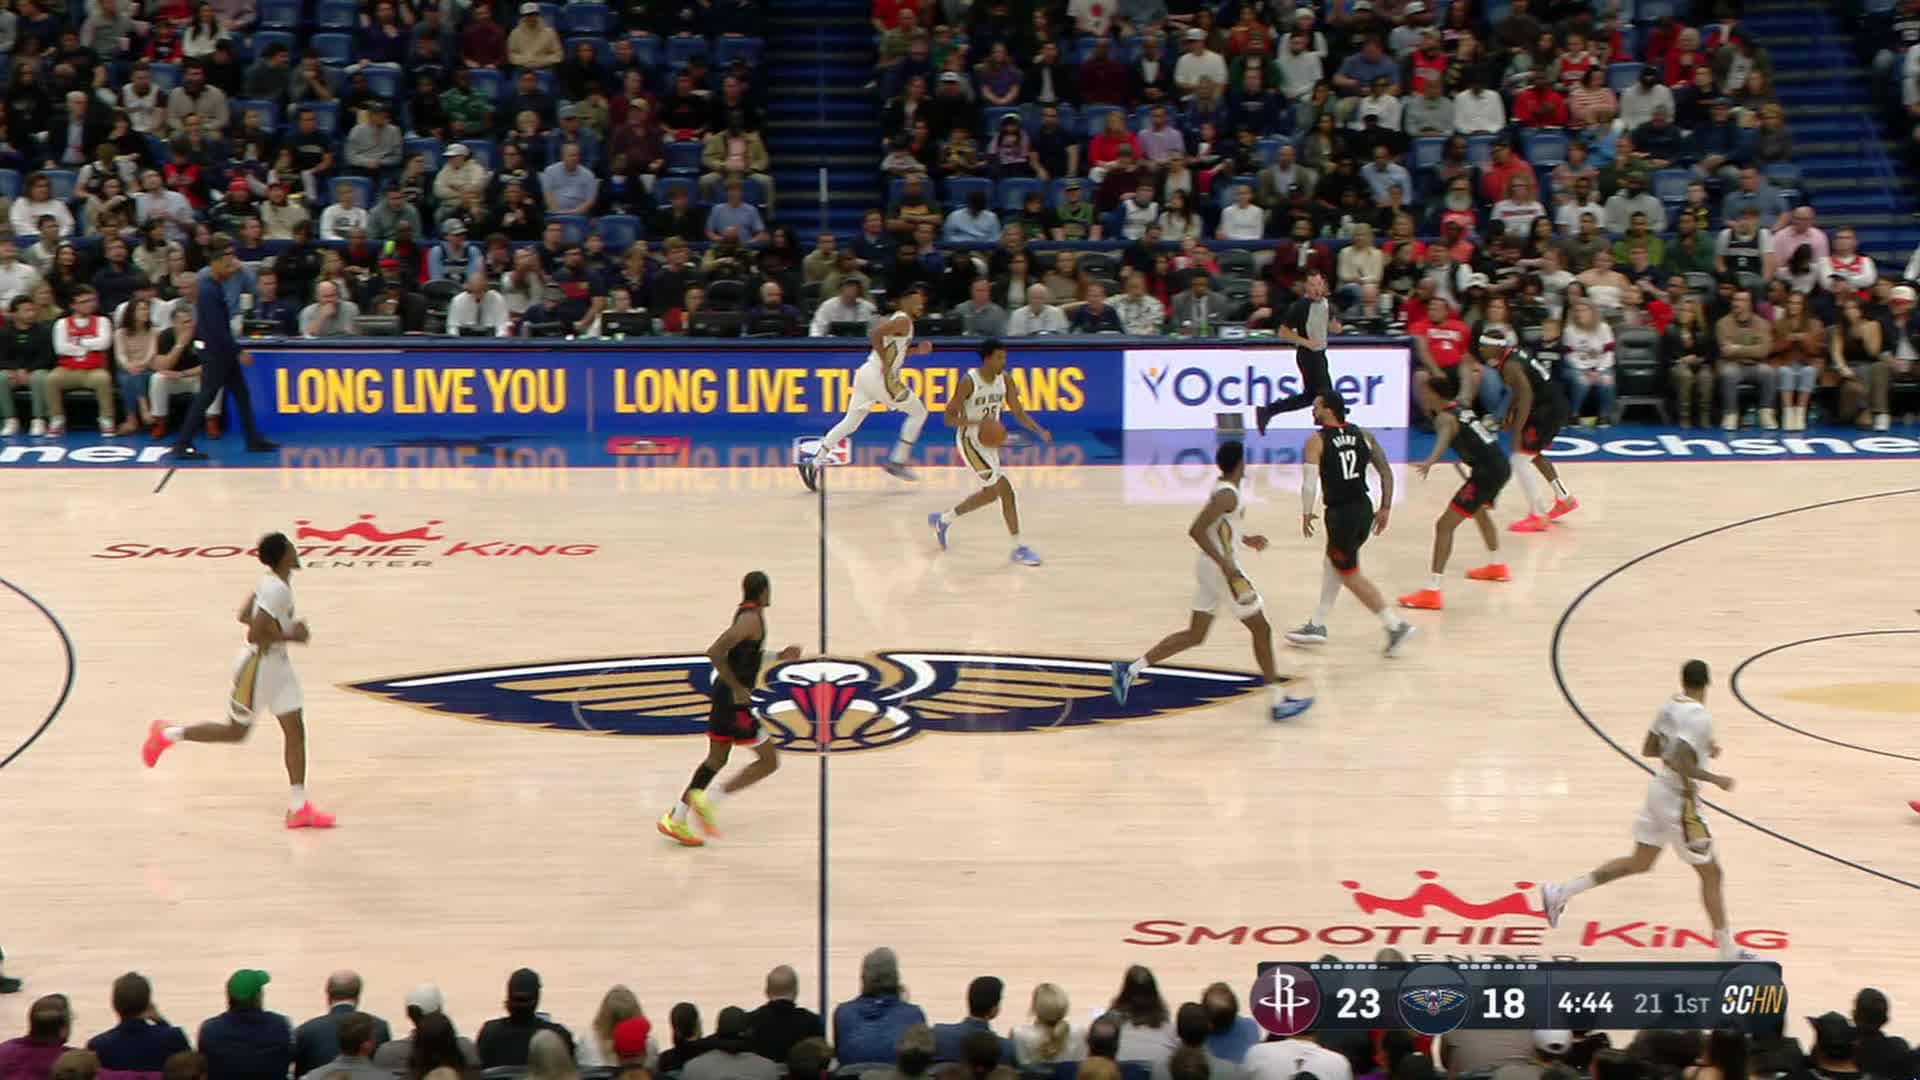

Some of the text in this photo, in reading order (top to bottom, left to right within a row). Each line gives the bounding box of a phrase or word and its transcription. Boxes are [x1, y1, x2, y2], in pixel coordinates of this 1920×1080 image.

[275, 368, 567, 413] LONG LIVE YOU
[614, 368, 719, 413] LONG
[726, 368, 808, 413] LIVE
[815, 368, 888, 413] TH
[1173, 366, 1384, 406] Ochser
[1338, 449, 1360, 480] 12
[92, 542, 421, 559] SMOTHIE
[305, 559, 434, 568] ENTER
[1123, 920, 1547, 946] SMOOTHIE
